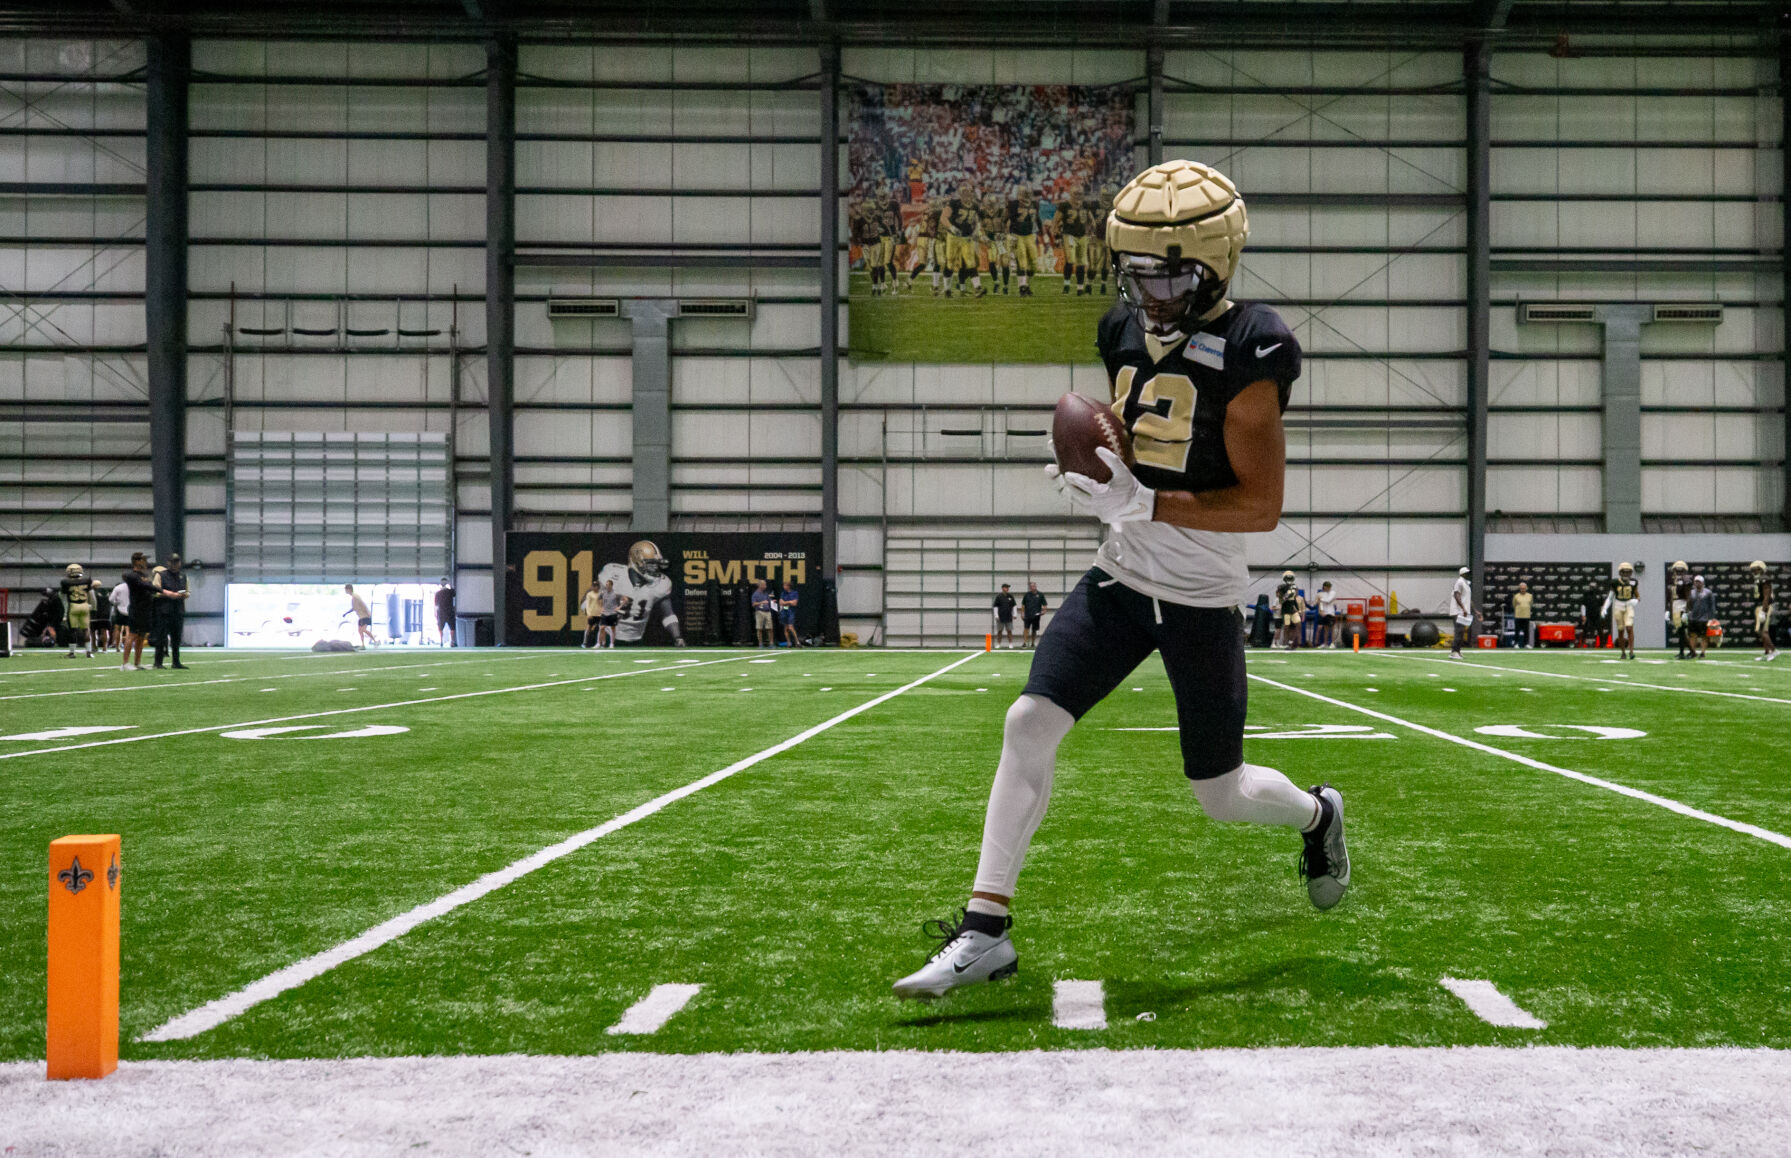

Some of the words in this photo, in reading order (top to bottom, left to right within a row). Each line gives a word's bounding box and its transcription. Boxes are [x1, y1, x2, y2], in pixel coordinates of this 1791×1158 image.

[1110, 365, 1198, 473] 12
[683, 550, 709, 559] WILL
[683, 560, 806, 584] SMITH
[523, 551, 594, 631] 91
